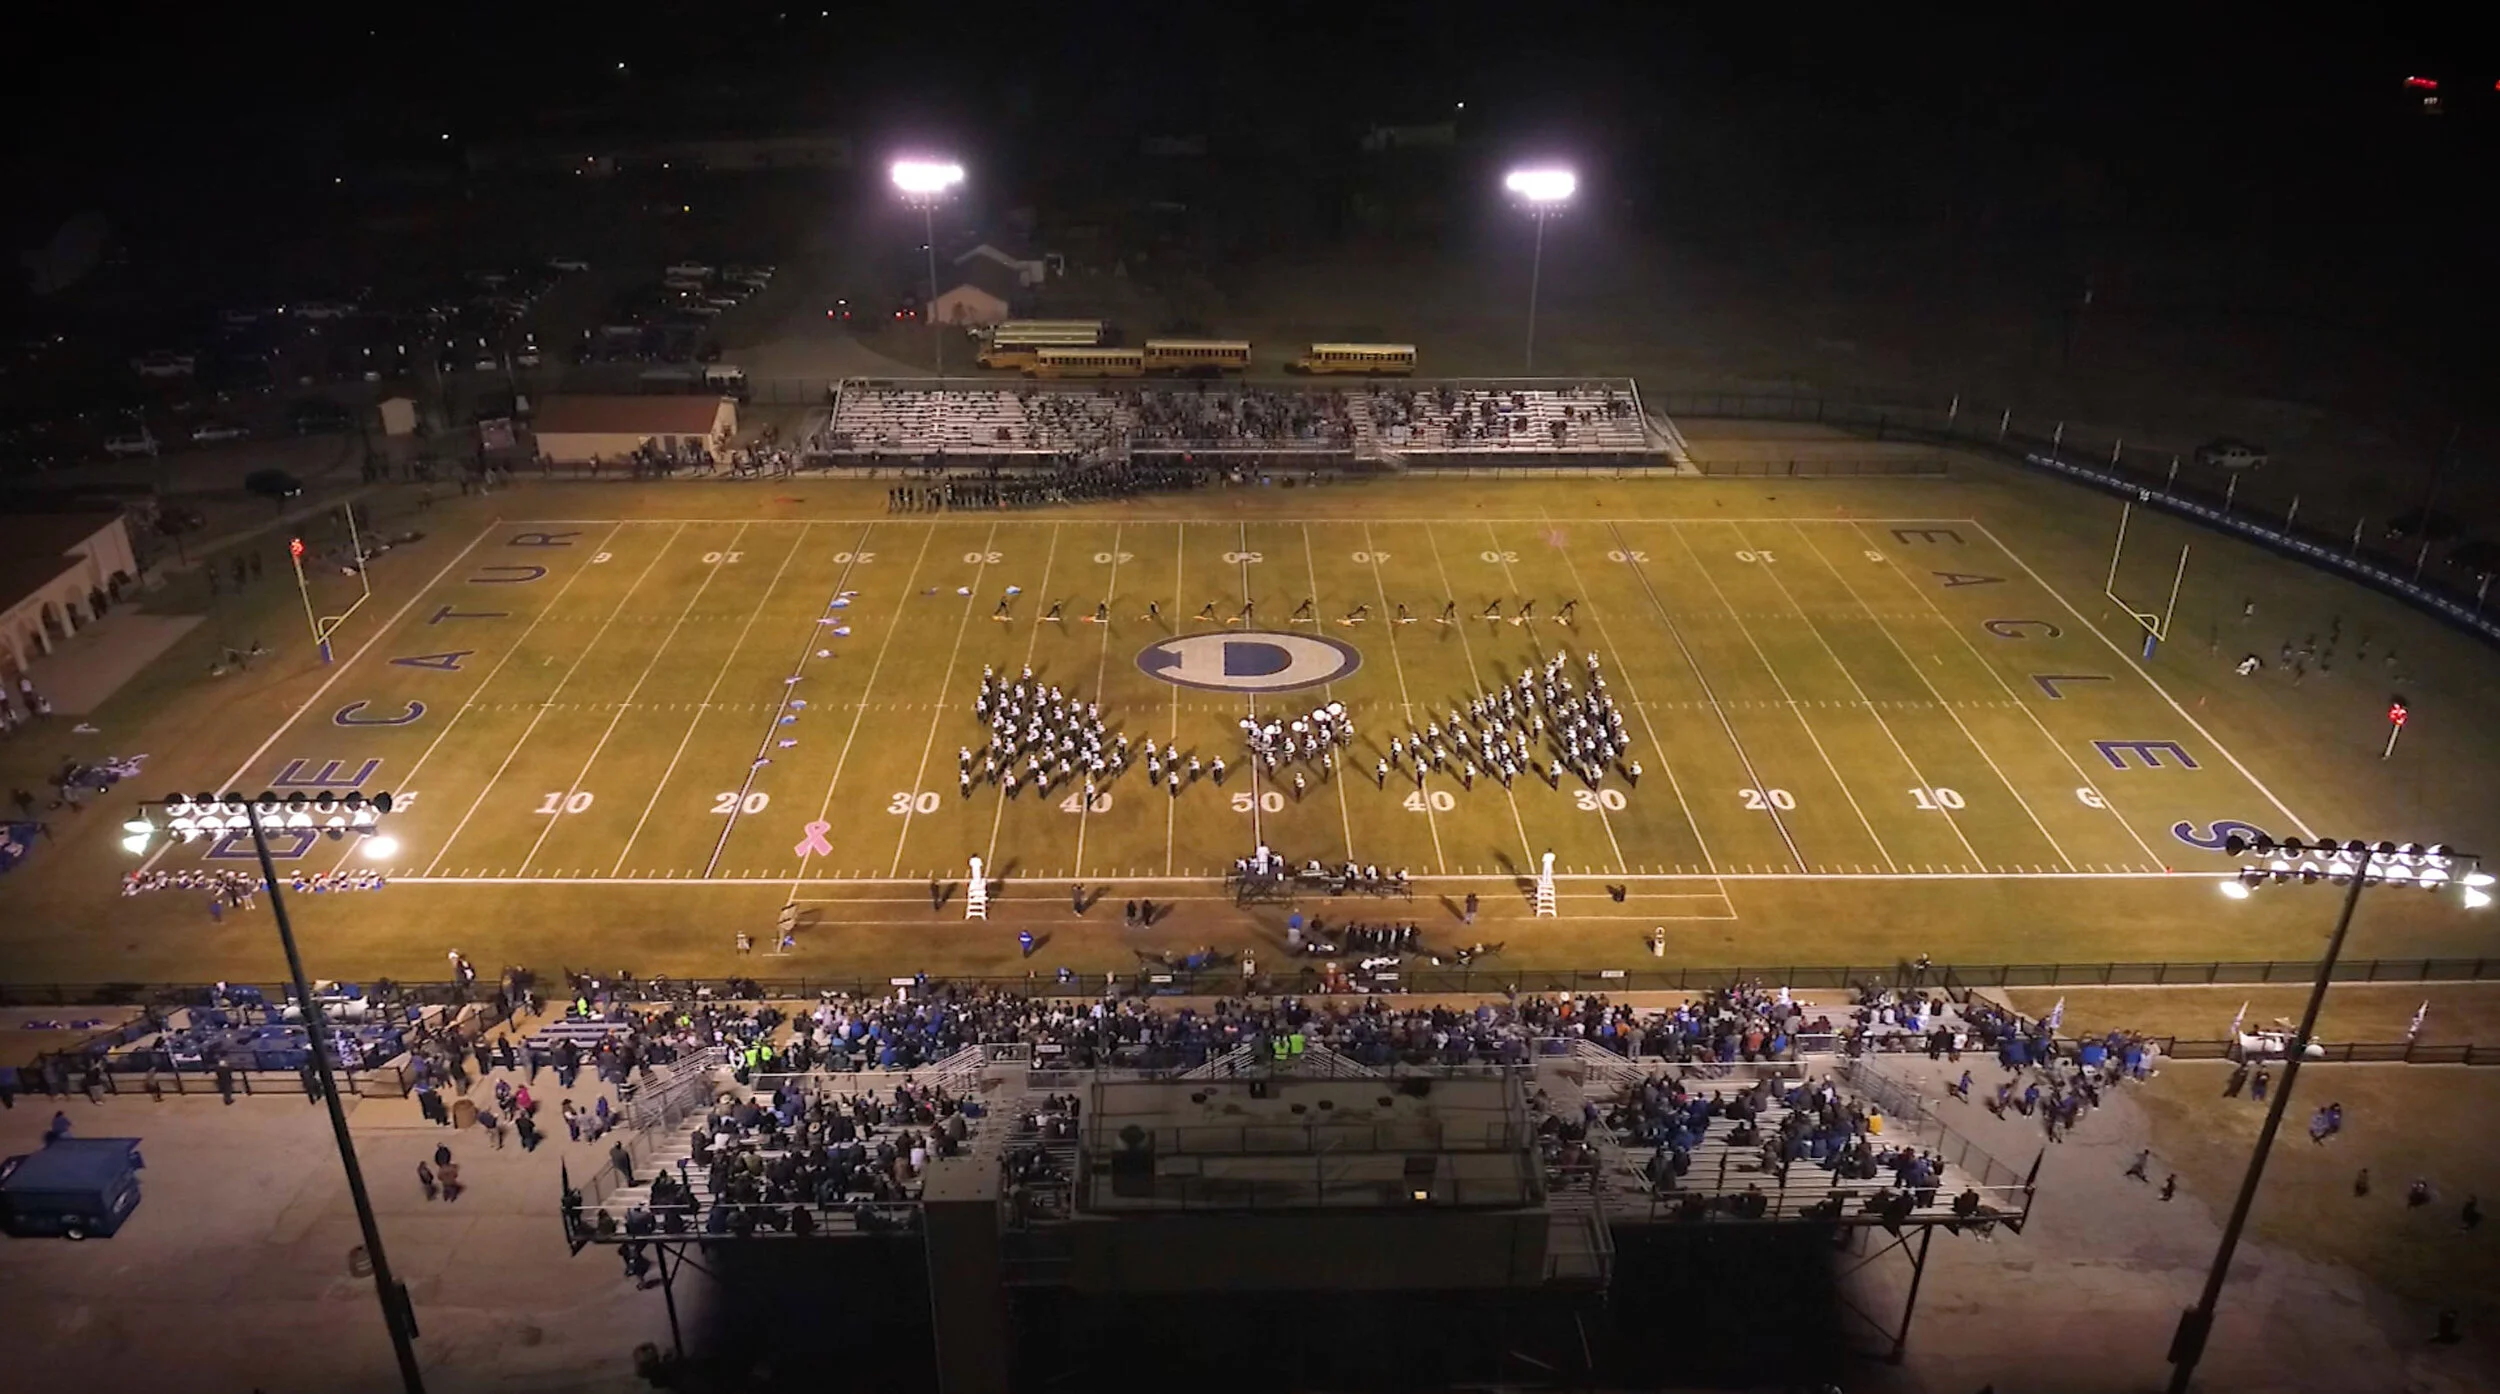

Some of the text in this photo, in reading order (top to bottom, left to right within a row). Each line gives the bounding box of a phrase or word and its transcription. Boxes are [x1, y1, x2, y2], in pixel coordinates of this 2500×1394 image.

[201, 530, 583, 860] DECATUR
[1891, 528, 2272, 851] EAGLES
[533, 791, 595, 814] 10
[710, 791, 770, 814] 20
[887, 791, 941, 814] 30
[1059, 791, 1113, 814] 40
[1231, 791, 1285, 813] 50
[1402, 790, 1456, 812] 40
[1573, 788, 1627, 811] 30
[1738, 788, 1796, 811] 20
[1908, 787, 1966, 810] 10
